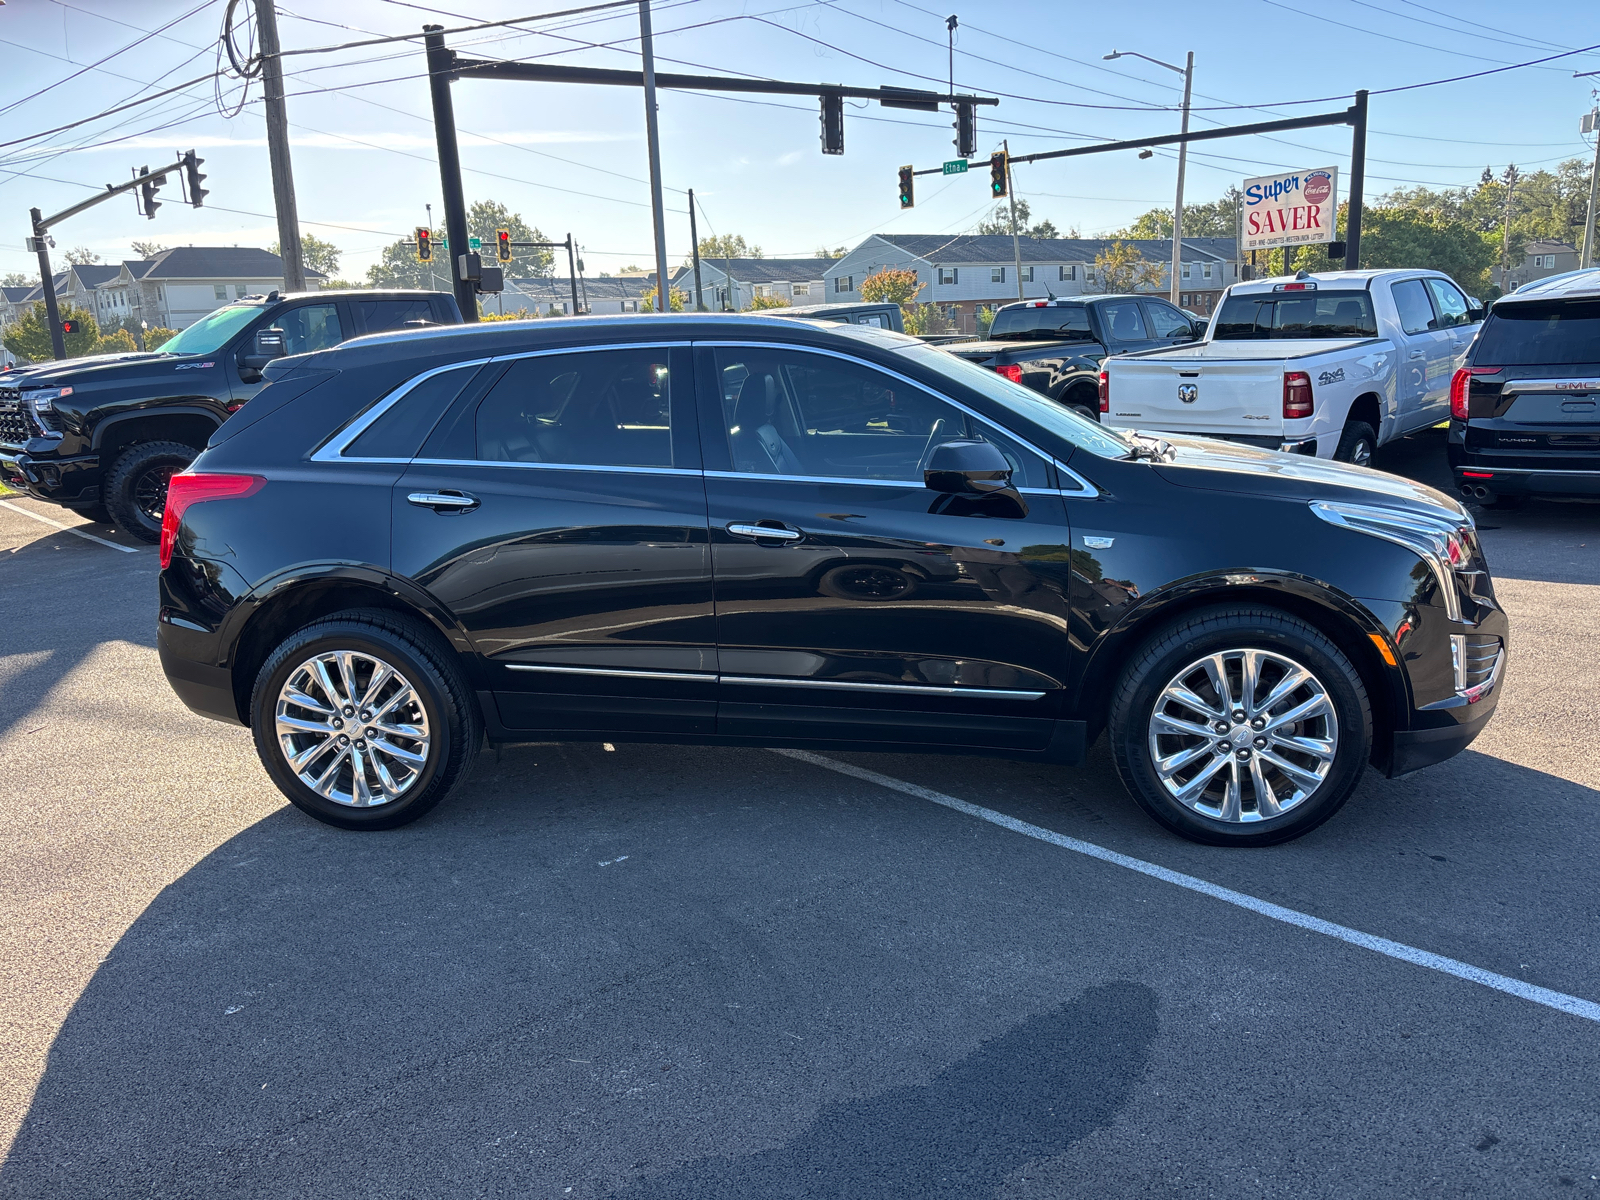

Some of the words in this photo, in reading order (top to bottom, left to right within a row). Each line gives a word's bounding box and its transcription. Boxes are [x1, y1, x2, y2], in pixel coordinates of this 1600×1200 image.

[945, 163, 961, 174] Etna
[1246, 175, 1299, 206] Super
[1248, 205, 1321, 236] SAVER
[1555, 381, 1597, 390] GMC
